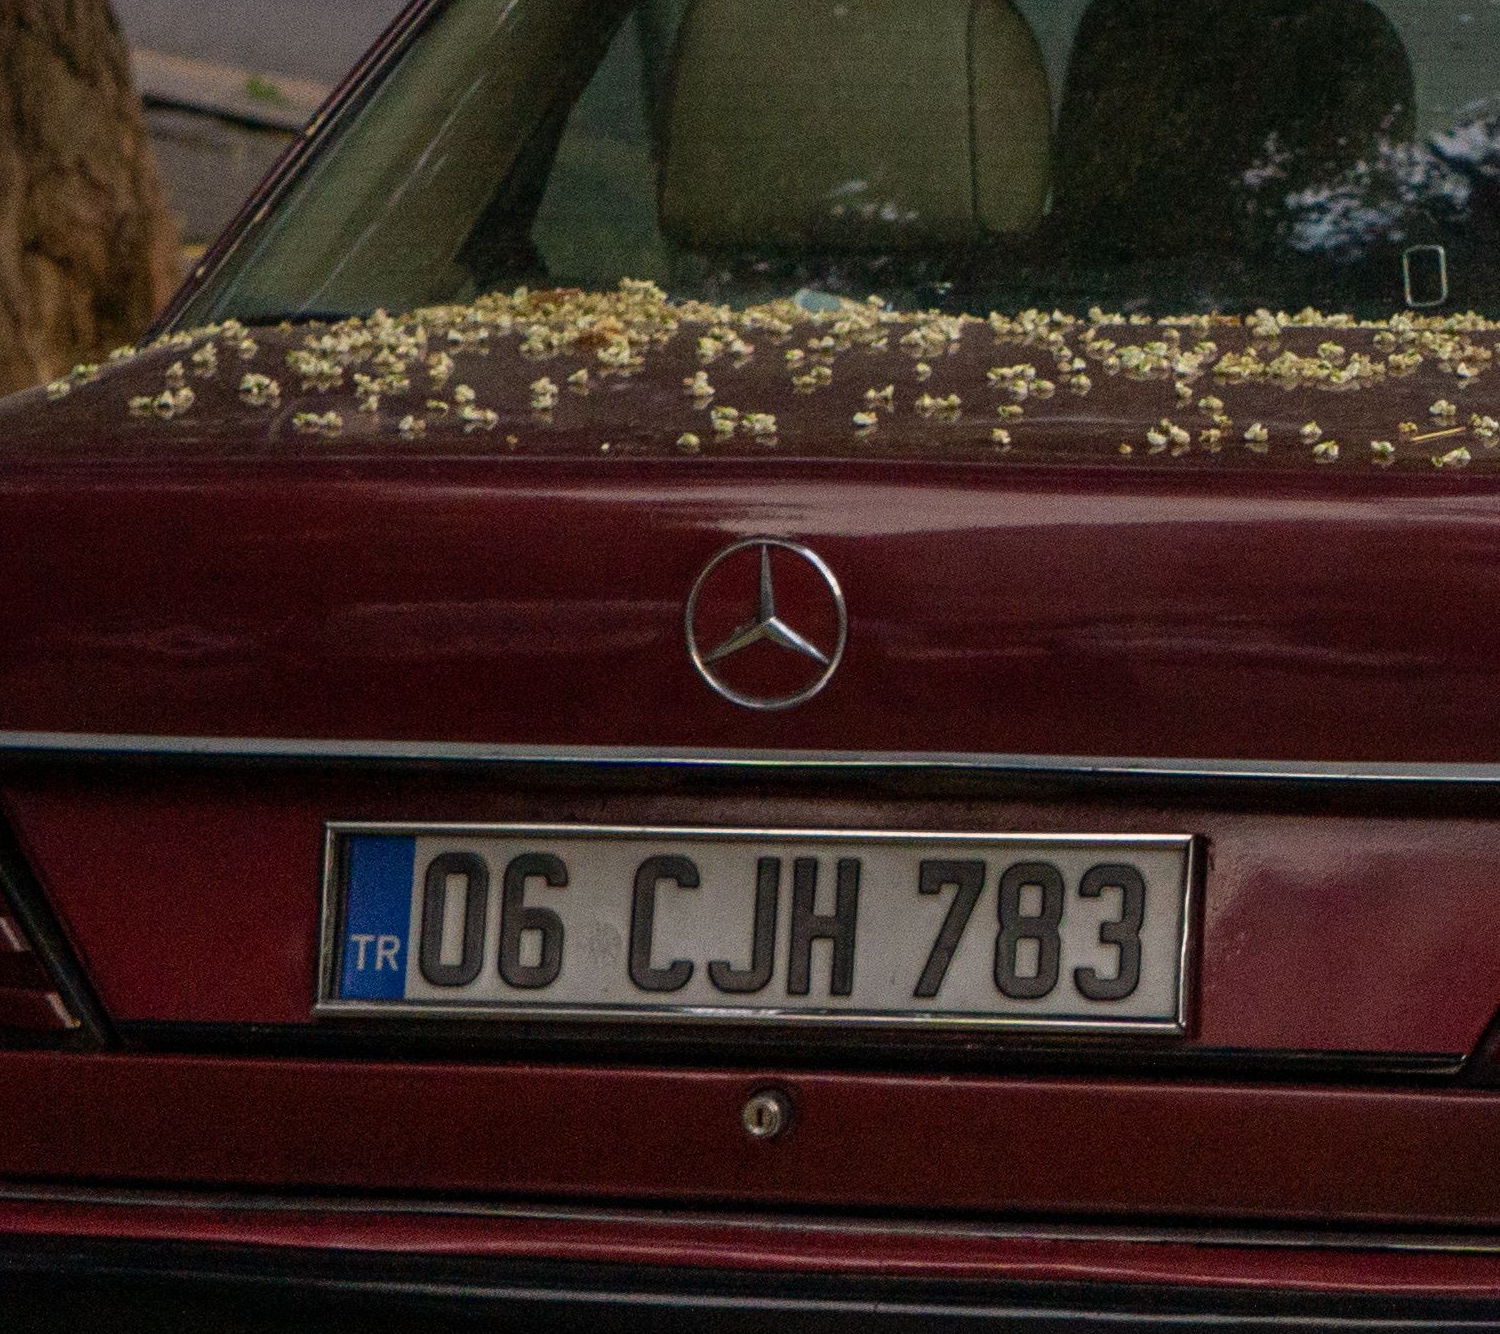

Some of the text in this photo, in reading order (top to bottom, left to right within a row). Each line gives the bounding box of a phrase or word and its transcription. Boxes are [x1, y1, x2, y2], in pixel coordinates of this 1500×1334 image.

[351, 934, 401, 971] TR
[418, 852, 1146, 1001] 06 CJH 783
